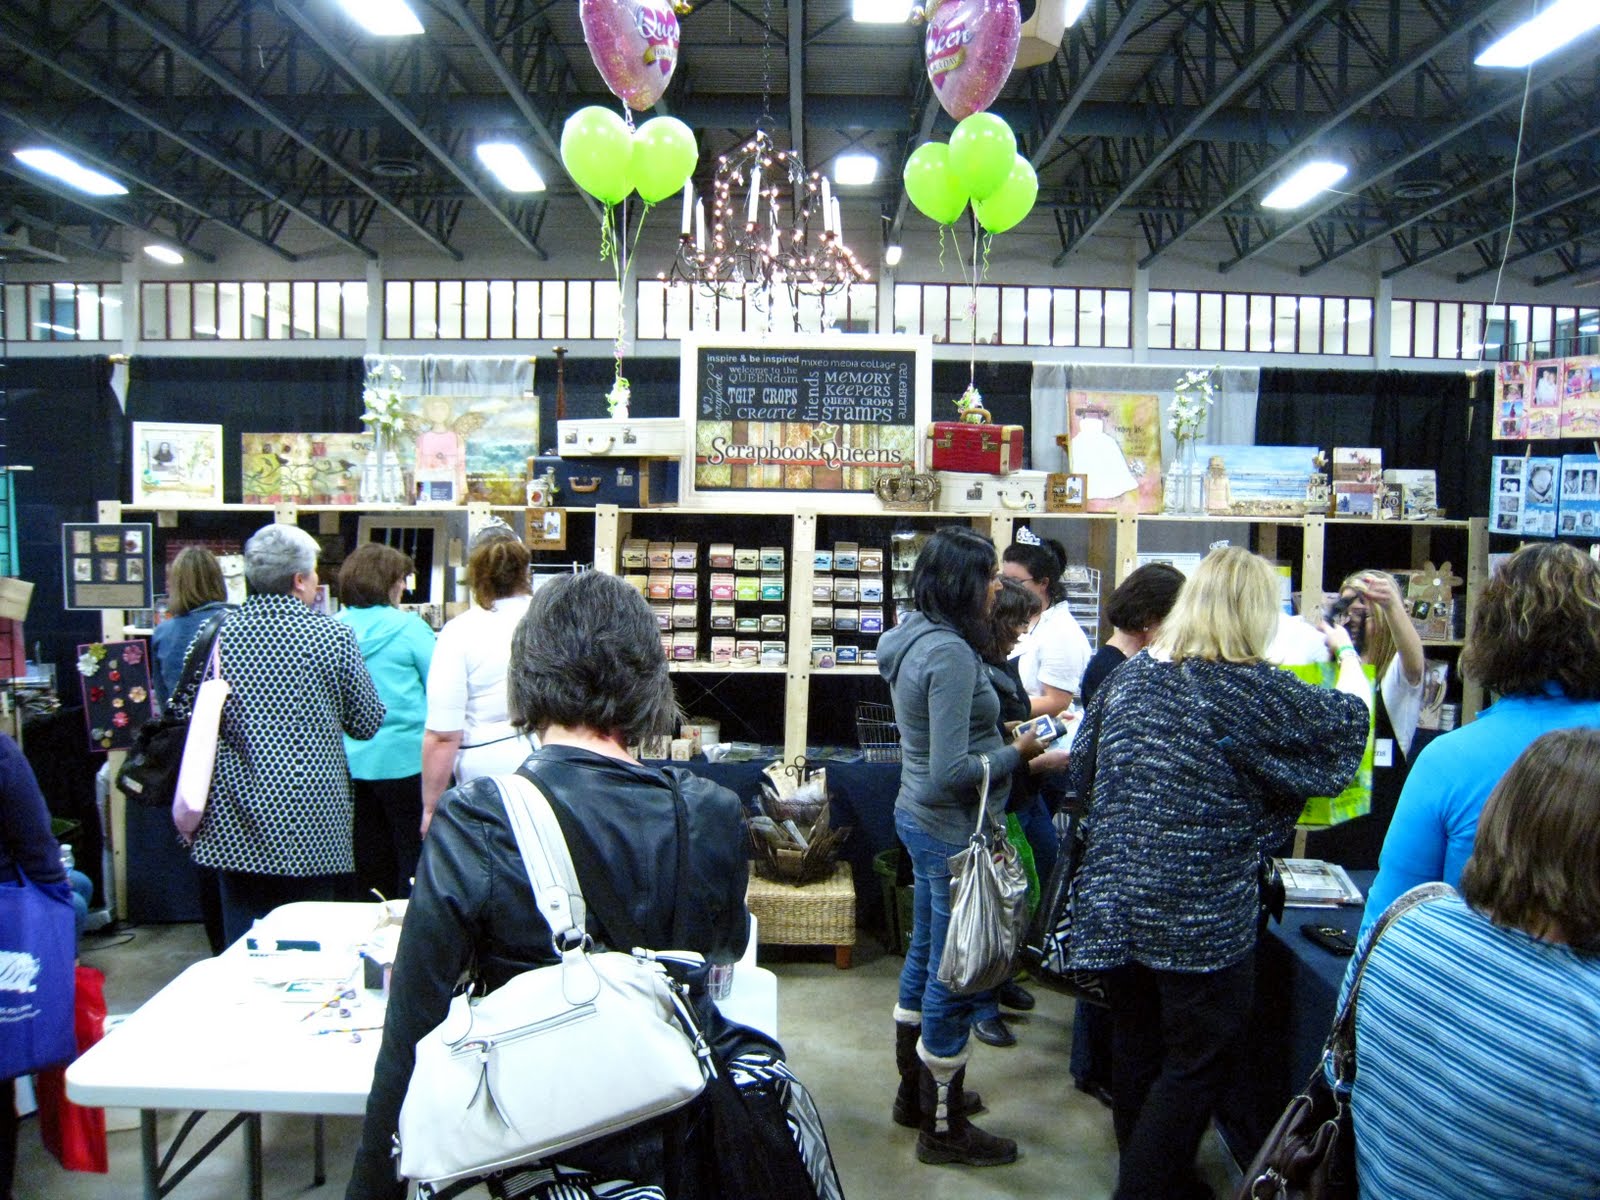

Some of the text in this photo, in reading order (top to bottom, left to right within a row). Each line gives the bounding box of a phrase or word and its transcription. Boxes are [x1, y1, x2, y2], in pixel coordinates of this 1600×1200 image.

[706, 354, 738, 364] inspire
[763, 355, 800, 364] inspired
[729, 365, 798, 374] welcome to the
[706, 362, 731, 420] scrapbook
[727, 386, 798, 405] TGIF CROPS
[802, 371, 820, 421] friends
[822, 396, 894, 407] QUEEN CROPS
